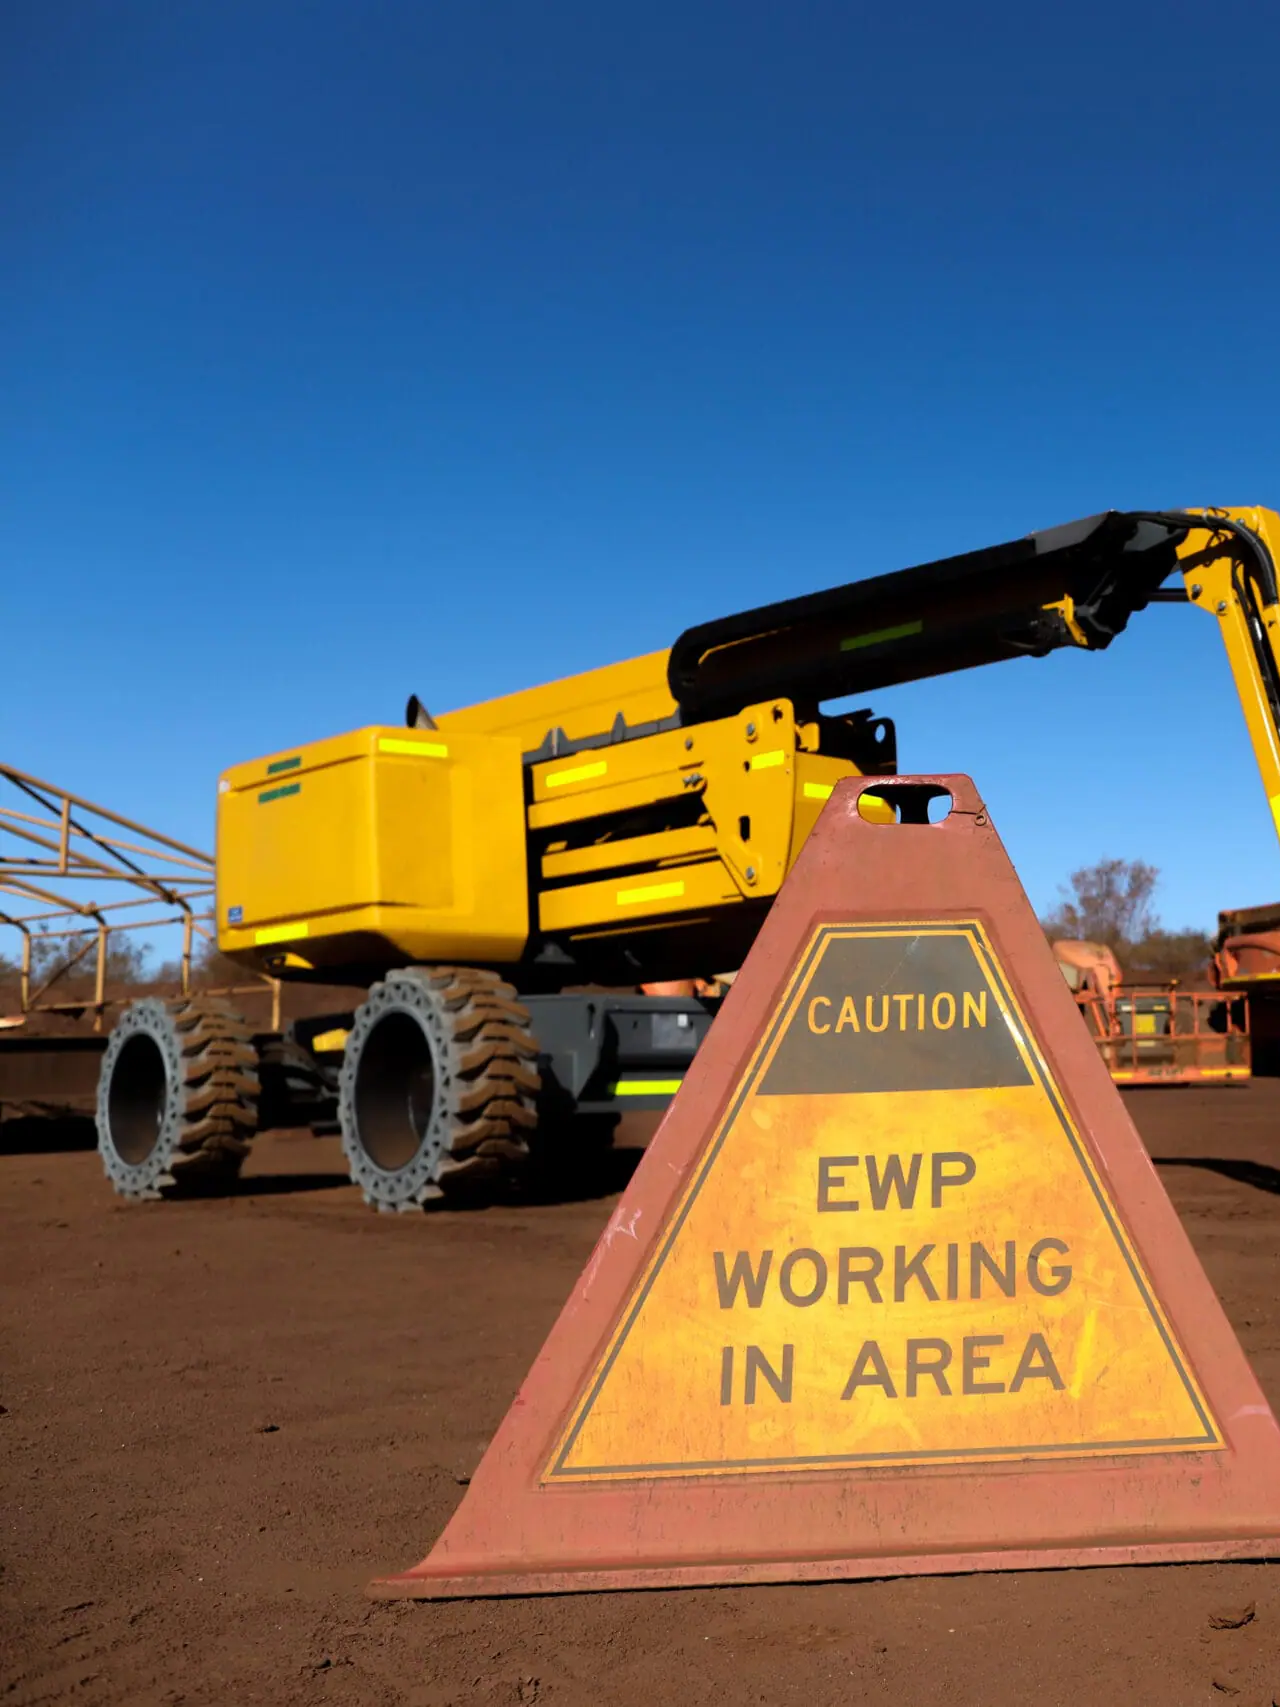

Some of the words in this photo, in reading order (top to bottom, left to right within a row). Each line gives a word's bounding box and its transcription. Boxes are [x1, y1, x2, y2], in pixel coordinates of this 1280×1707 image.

[808, 991, 987, 1034] CAUTION
[817, 1152, 975, 1212] EWP
[713, 1238, 1072, 1309] WORKING
[720, 1344, 794, 1406] IN
[840, 1333, 1066, 1400] AREA
